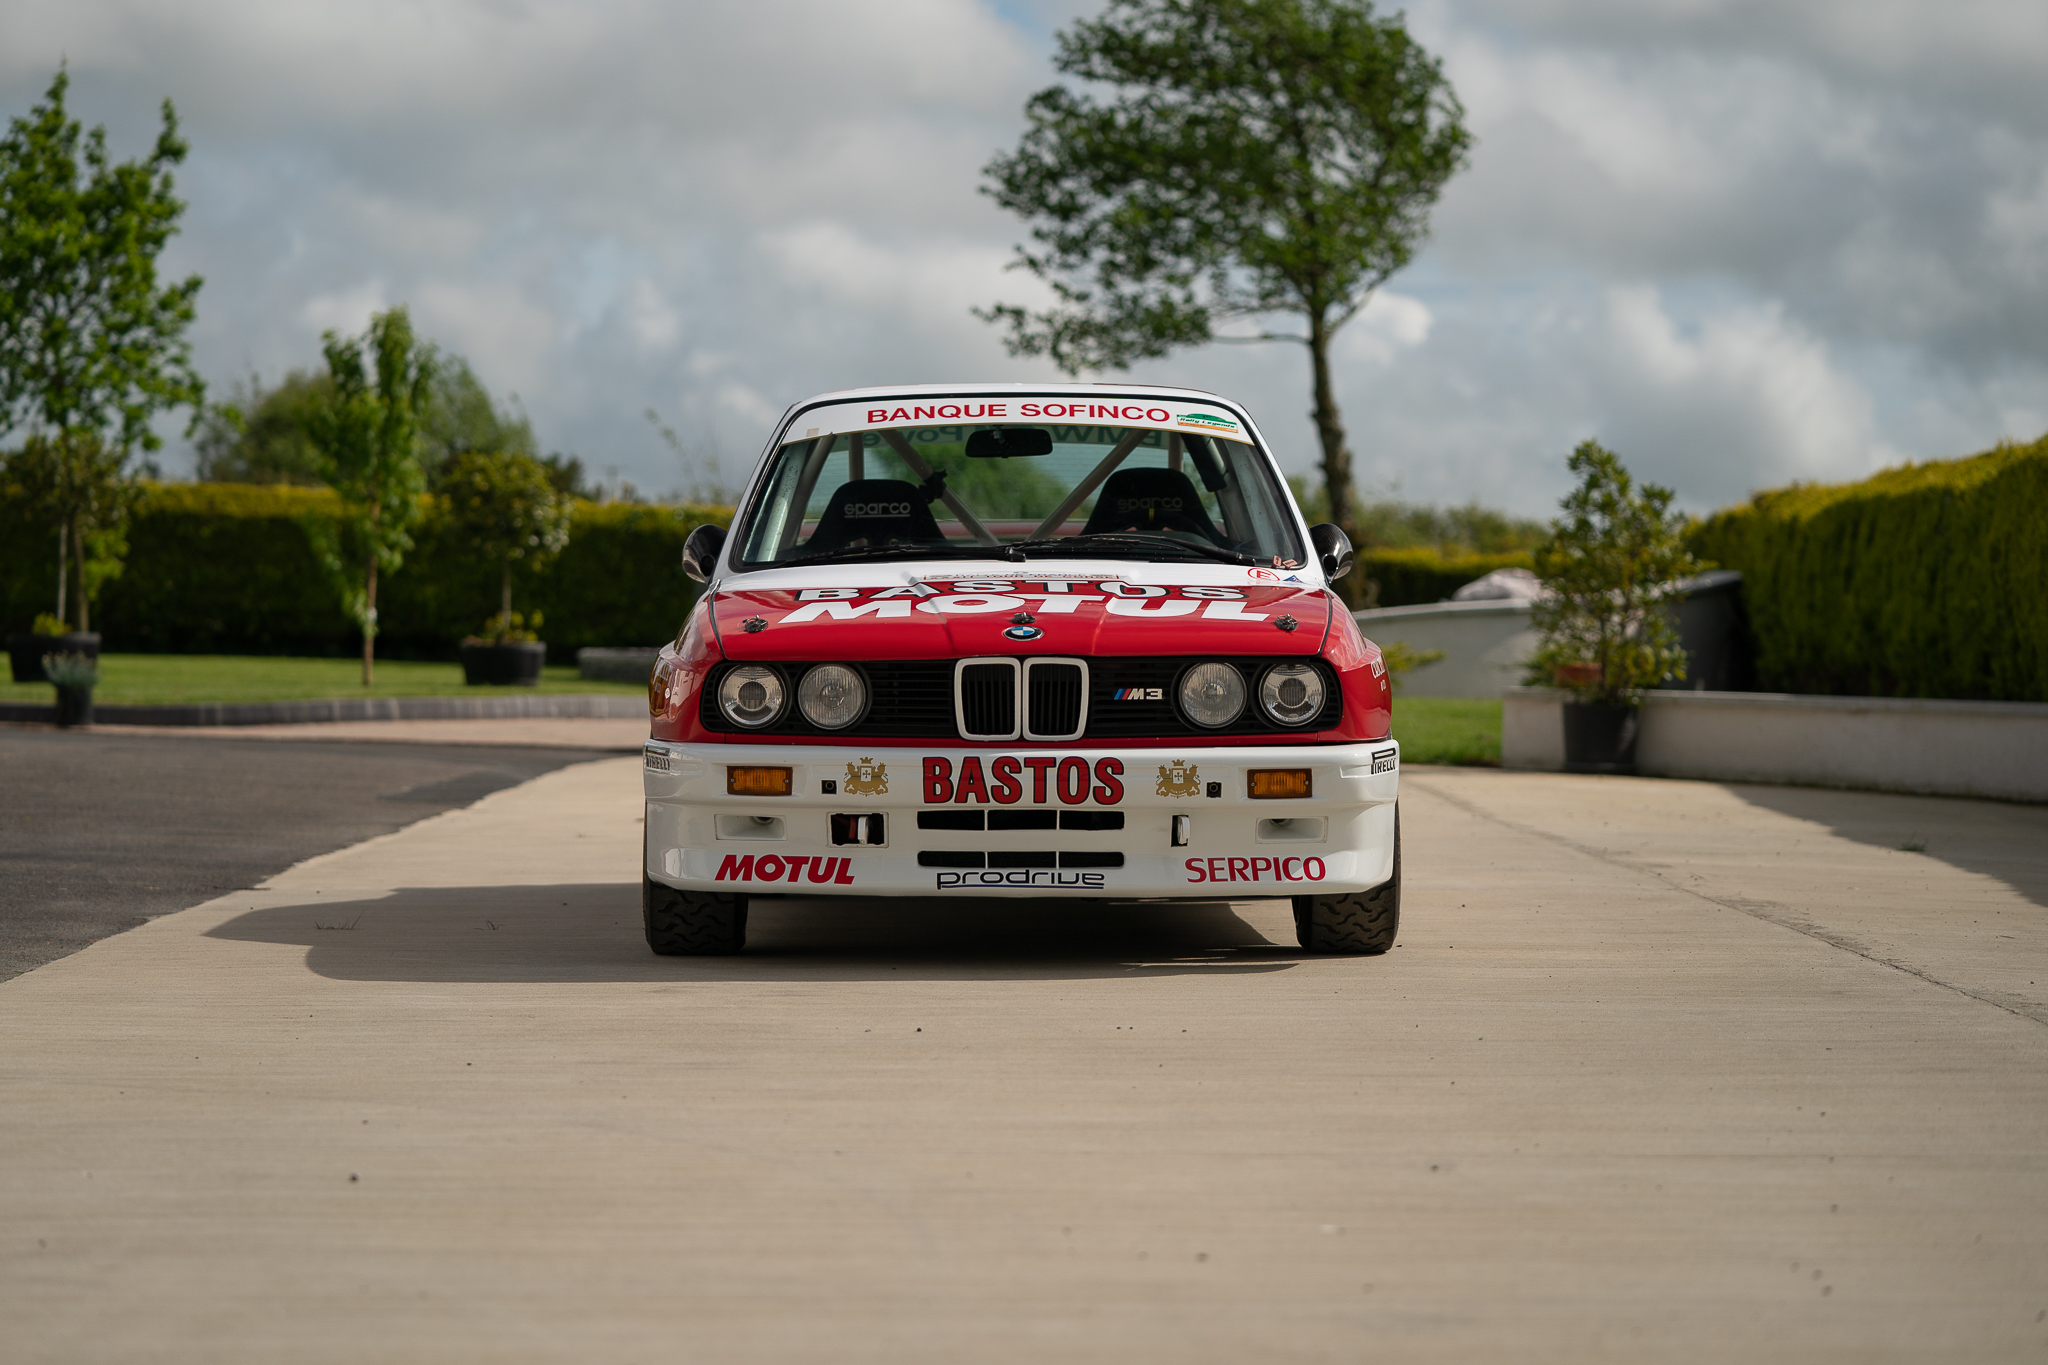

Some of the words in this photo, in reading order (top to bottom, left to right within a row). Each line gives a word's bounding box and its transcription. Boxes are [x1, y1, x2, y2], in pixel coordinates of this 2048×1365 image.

[867, 404, 1007, 424] BANQUE
[1020, 404, 1170, 422] SOFINCO
[844, 502, 911, 519] sparco
[1117, 497, 1183, 512] sparco
[795, 579, 1249, 601] BASTOS
[778, 593, 1271, 623] MOTUL
[1127, 688, 1163, 700] M3
[1371, 747, 1396, 775] PIRELLI
[922, 756, 1124, 805] BASTOS
[714, 854, 855, 885] MOTUL
[936, 869, 1105, 890] prodrive
[1185, 856, 1326, 883] SERPICO
